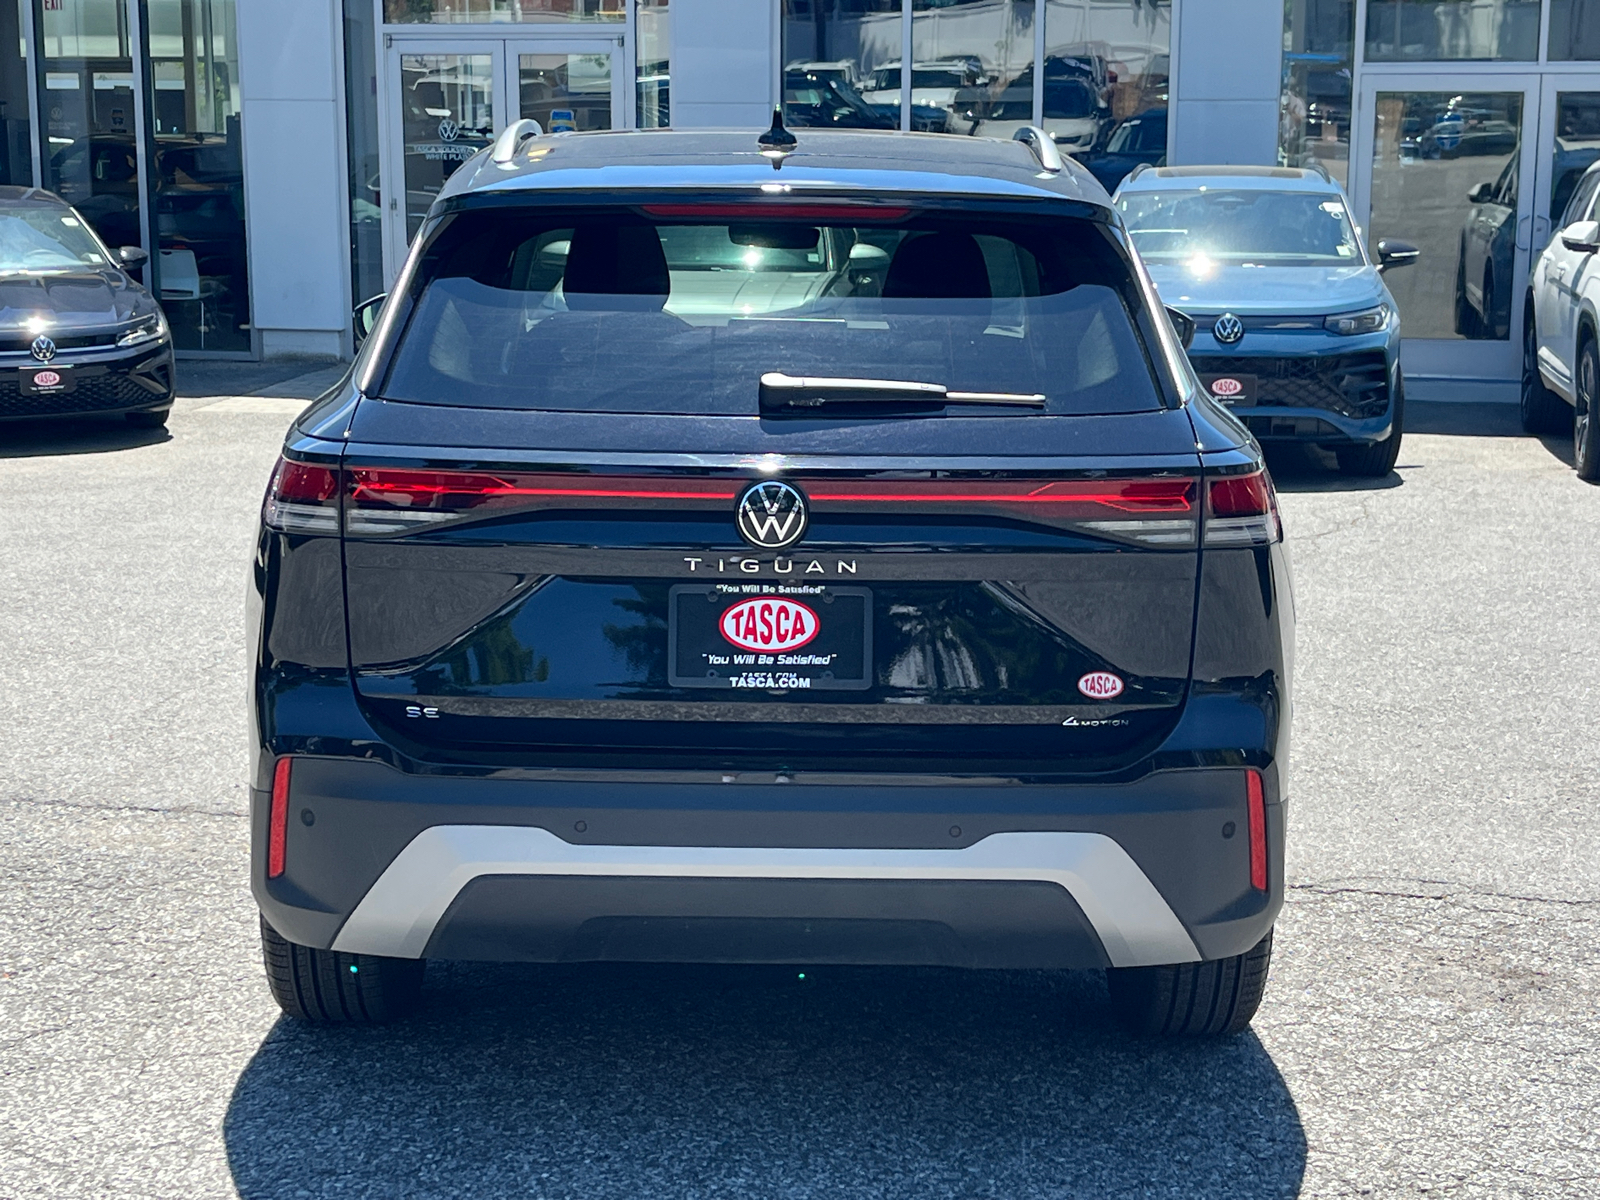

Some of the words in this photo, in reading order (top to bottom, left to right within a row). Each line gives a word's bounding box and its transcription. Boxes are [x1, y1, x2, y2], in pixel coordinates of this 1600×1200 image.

[426, 153, 447, 161] WHITE
[37, 373, 58, 384] TASCA
[1215, 381, 1238, 393] TASCA
[683, 557, 857, 574] TIGUAN
[742, 585, 760, 593] Will
[762, 585, 775, 593] Be
[731, 603, 806, 645] TASCA
[733, 655, 755, 665] Will
[758, 655, 774, 665] Be
[729, 677, 811, 688] TASCA.COM
[1084, 675, 1117, 694] TASCA
[405, 705, 440, 718] SE
[1062, 716, 1129, 727] 4MOTION
